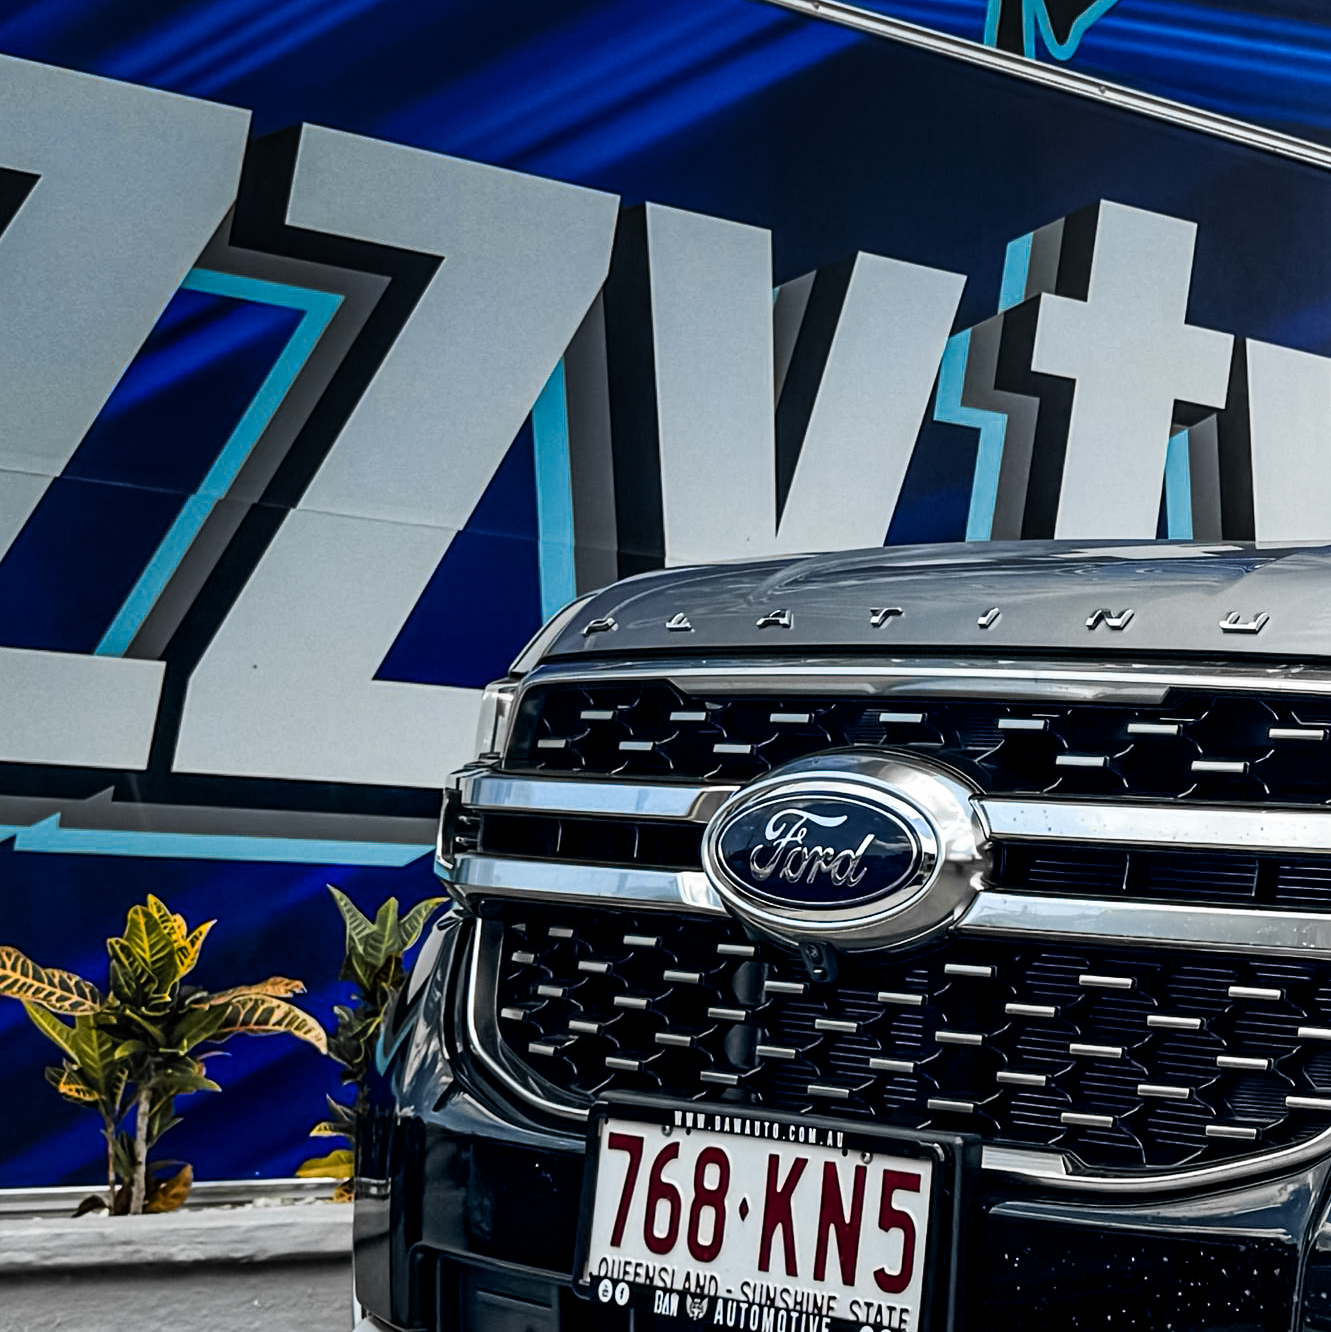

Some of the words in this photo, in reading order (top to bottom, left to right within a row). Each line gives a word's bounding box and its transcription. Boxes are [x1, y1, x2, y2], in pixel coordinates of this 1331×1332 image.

[750, 808, 876, 887] Ford
[598, 1256, 719, 1297] QUEENSLAND
[740, 1280, 838, 1317] SUNSHINE
[850, 1299, 911, 1330] STATE
